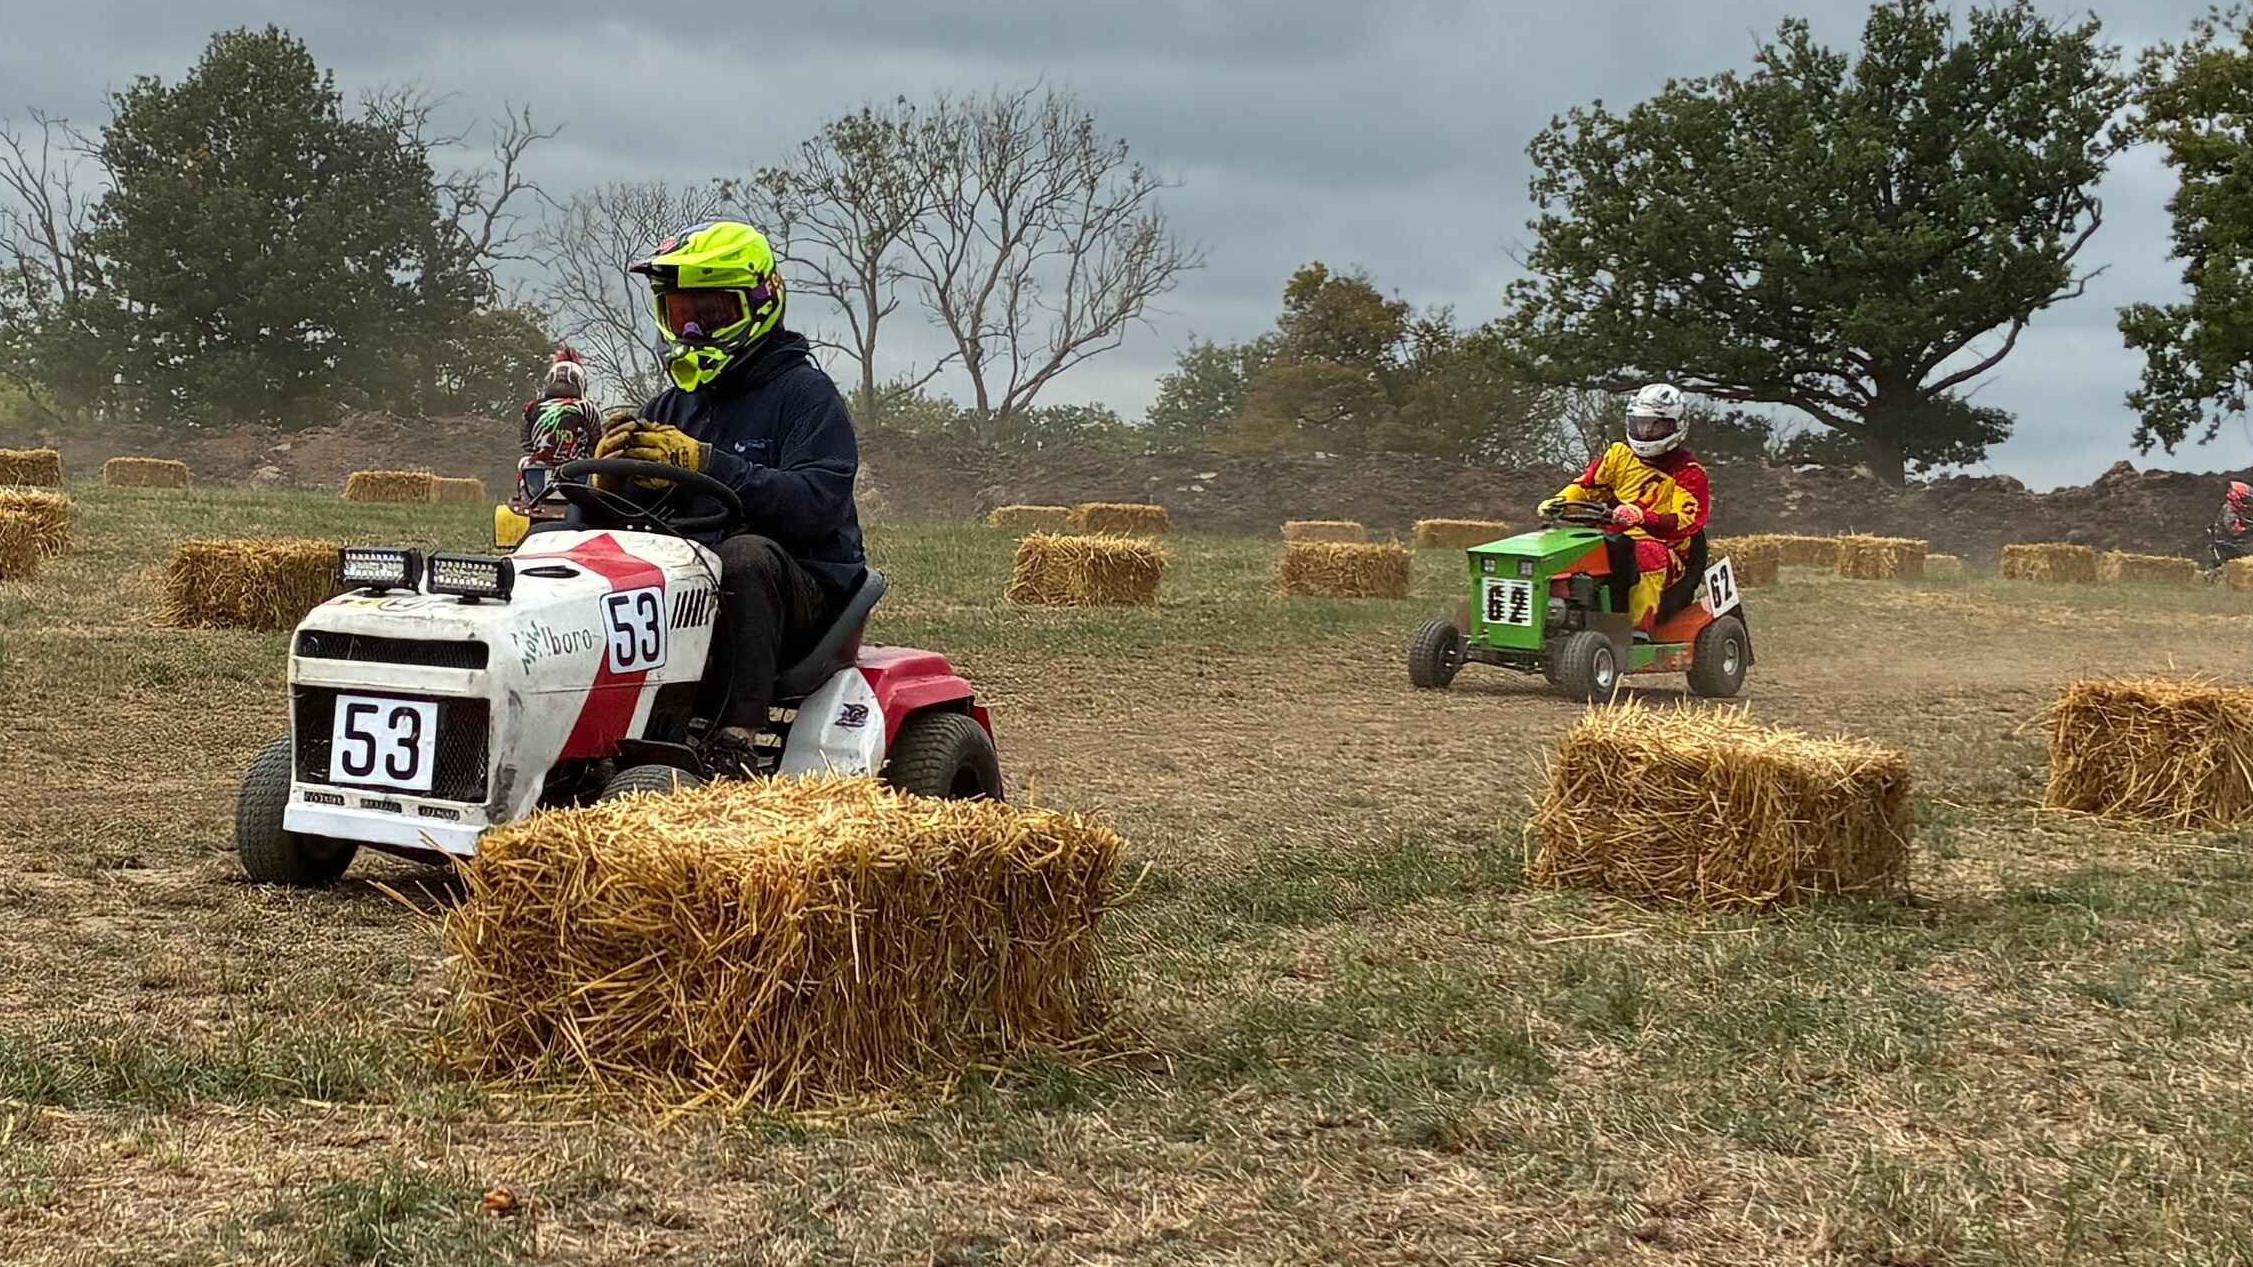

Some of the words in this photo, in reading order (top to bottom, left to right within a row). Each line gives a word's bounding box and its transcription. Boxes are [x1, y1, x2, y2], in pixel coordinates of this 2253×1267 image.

[1710, 564, 1732, 608] 62
[608, 592, 660, 667] 53
[342, 703, 421, 780] 53
